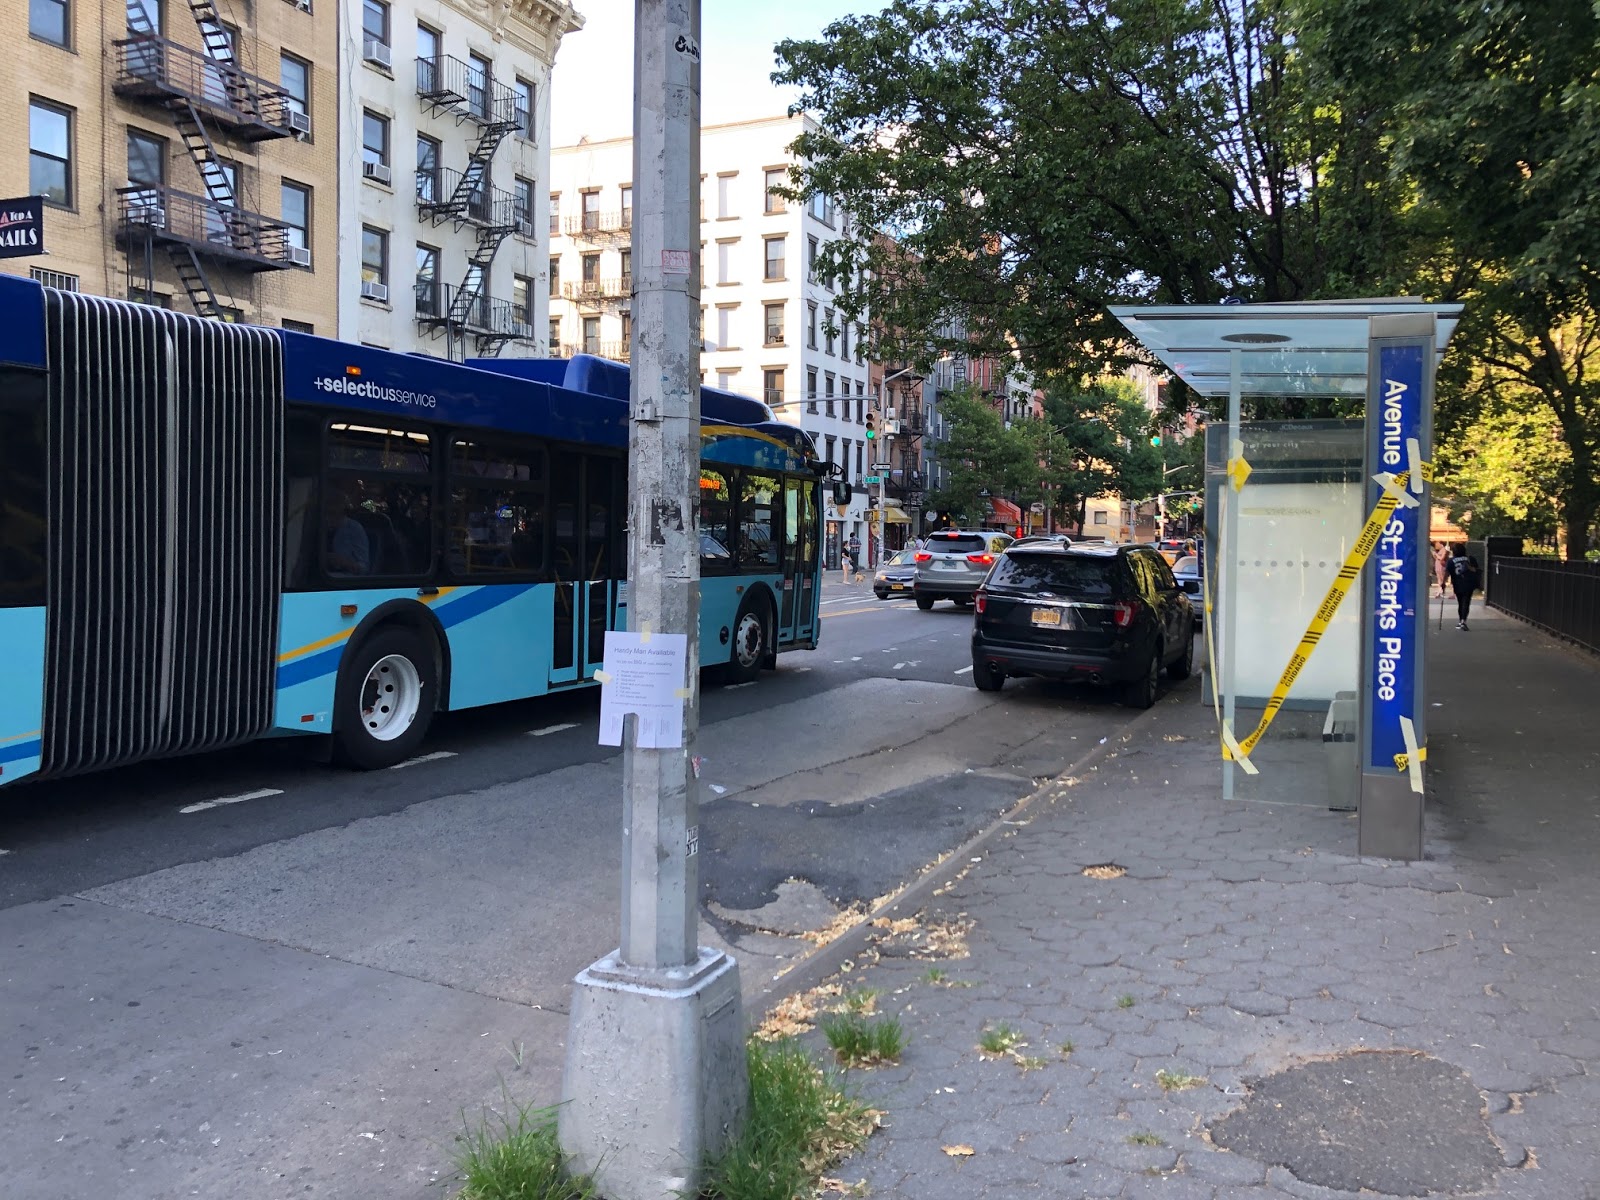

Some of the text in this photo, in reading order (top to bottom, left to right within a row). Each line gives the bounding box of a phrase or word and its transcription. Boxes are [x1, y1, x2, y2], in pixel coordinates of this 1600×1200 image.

[9, 210, 33, 221] Top A
[1383, 379, 1408, 465] Avenue
[1355, 521, 1376, 553] CAUTION
[1361, 524, 1382, 556] CUIDADO
[1381, 519, 1405, 550] St.
[1318, 588, 1338, 619] CAUTION
[1324, 591, 1344, 622] CUIDADO
[1379, 559, 1403, 630] Marks
[614, 647, 632, 655] Handy
[1281, 654, 1300, 684] CAUTION
[1285, 656, 1306, 687] CUIDADO
[1378, 637, 1402, 701] Place
